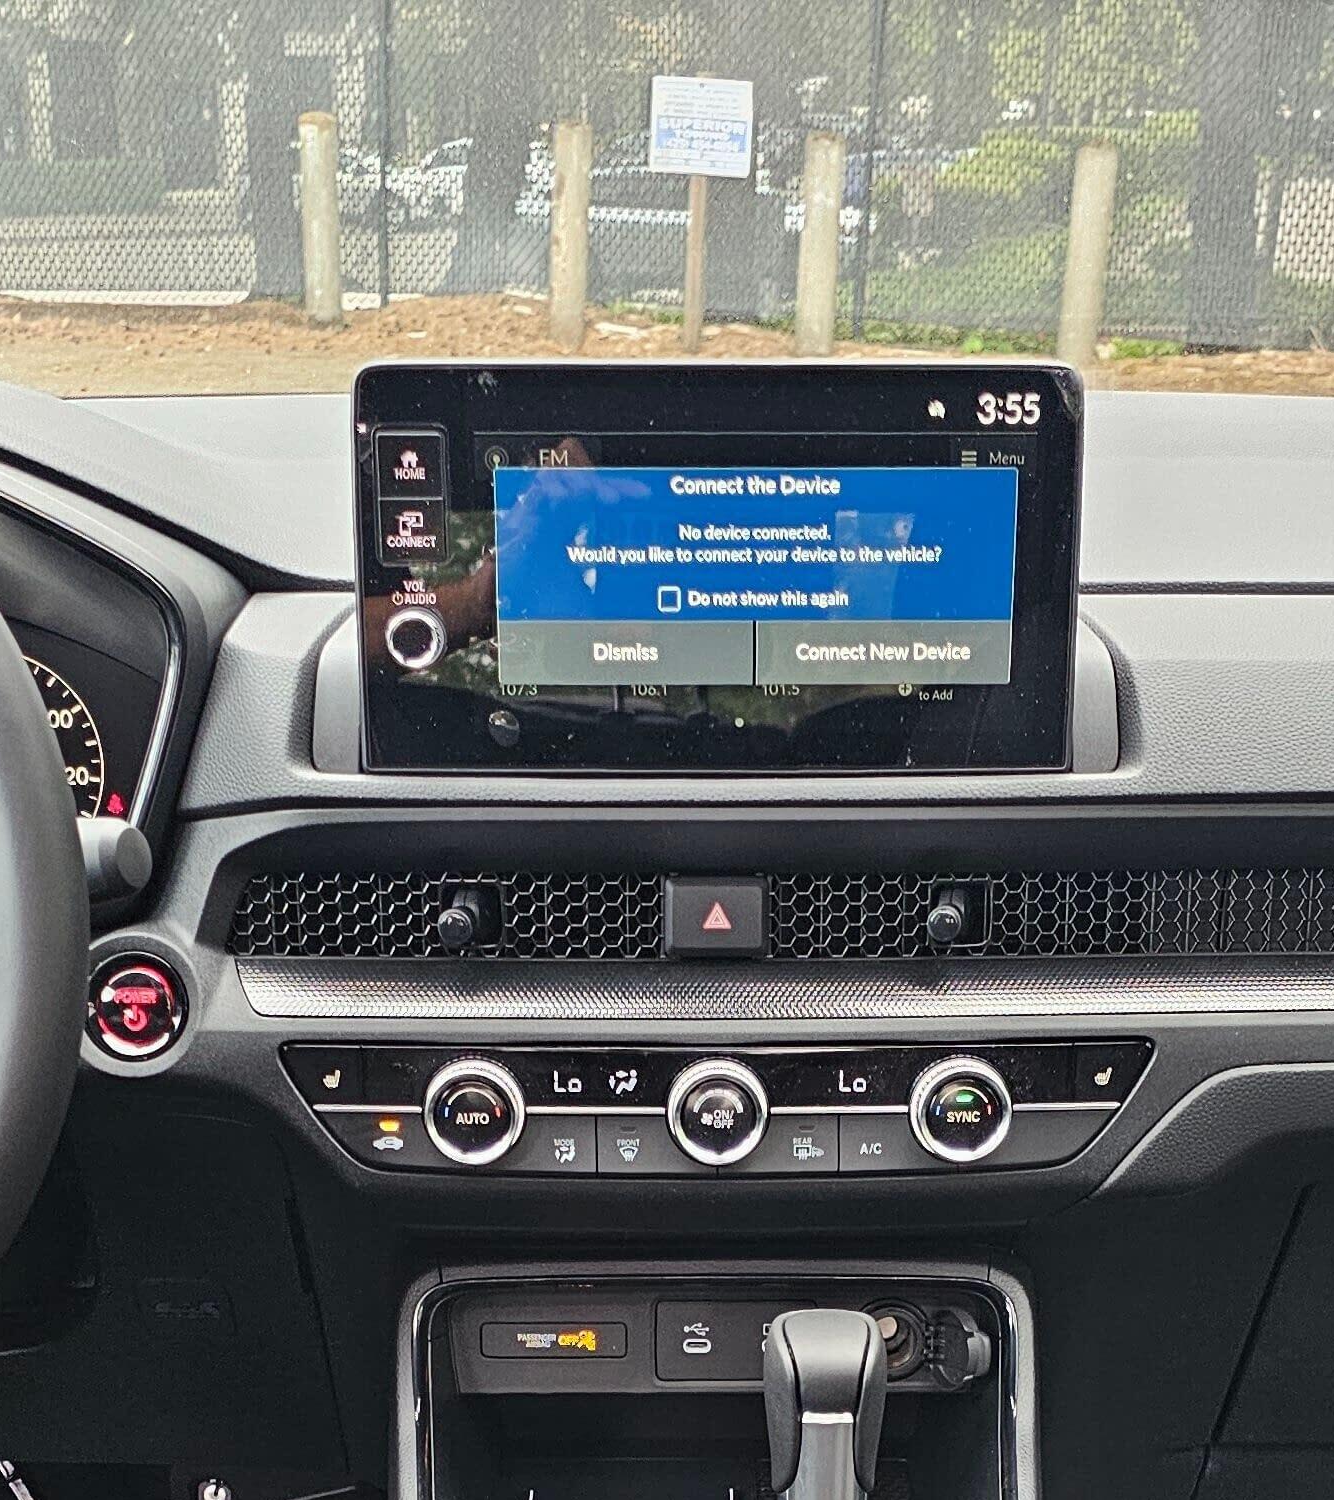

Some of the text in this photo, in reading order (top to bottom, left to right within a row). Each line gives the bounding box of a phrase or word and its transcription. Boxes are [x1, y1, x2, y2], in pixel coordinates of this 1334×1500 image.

[659, 118, 745, 135] SUPERIOR
[976, 392, 1041, 425] 3:55
[539, 449, 568, 466] FM
[989, 451, 1025, 465] Menu
[394, 468, 425, 480] HOME
[670, 475, 841, 495] Connect the Device
[678, 524, 831, 541] No device connected.
[387, 536, 436, 548] CONNECT
[566, 546, 942, 565] Would you like to connect your device to the vehicle?
[403, 580, 425, 592] VOL
[405, 592, 436, 604] AUDIO
[688, 590, 849, 608] Do not show this again
[593, 642, 659, 661] Dismiss
[796, 642, 971, 661] Connect New Device
[762, 684, 800, 696] 101.5
[919, 689, 954, 701] to Add
[47, 709, 73, 728] 00
[66, 766, 90, 785] 20
[114, 987, 158, 1003] POWER
[553, 1070, 582, 1093] Lo
[839, 1070, 867, 1093] Lo
[455, 1112, 490, 1125] AUTO
[713, 1109, 734, 1120] ON/
[946, 1111, 980, 1124] SYNC
[713, 1119, 734, 1129] OFF
[554, 1138, 575, 1147] MODE
[616, 1138, 640, 1147] FRONT
[793, 1137, 812, 1145] REAR
[860, 1142, 883, 1154] A/C
